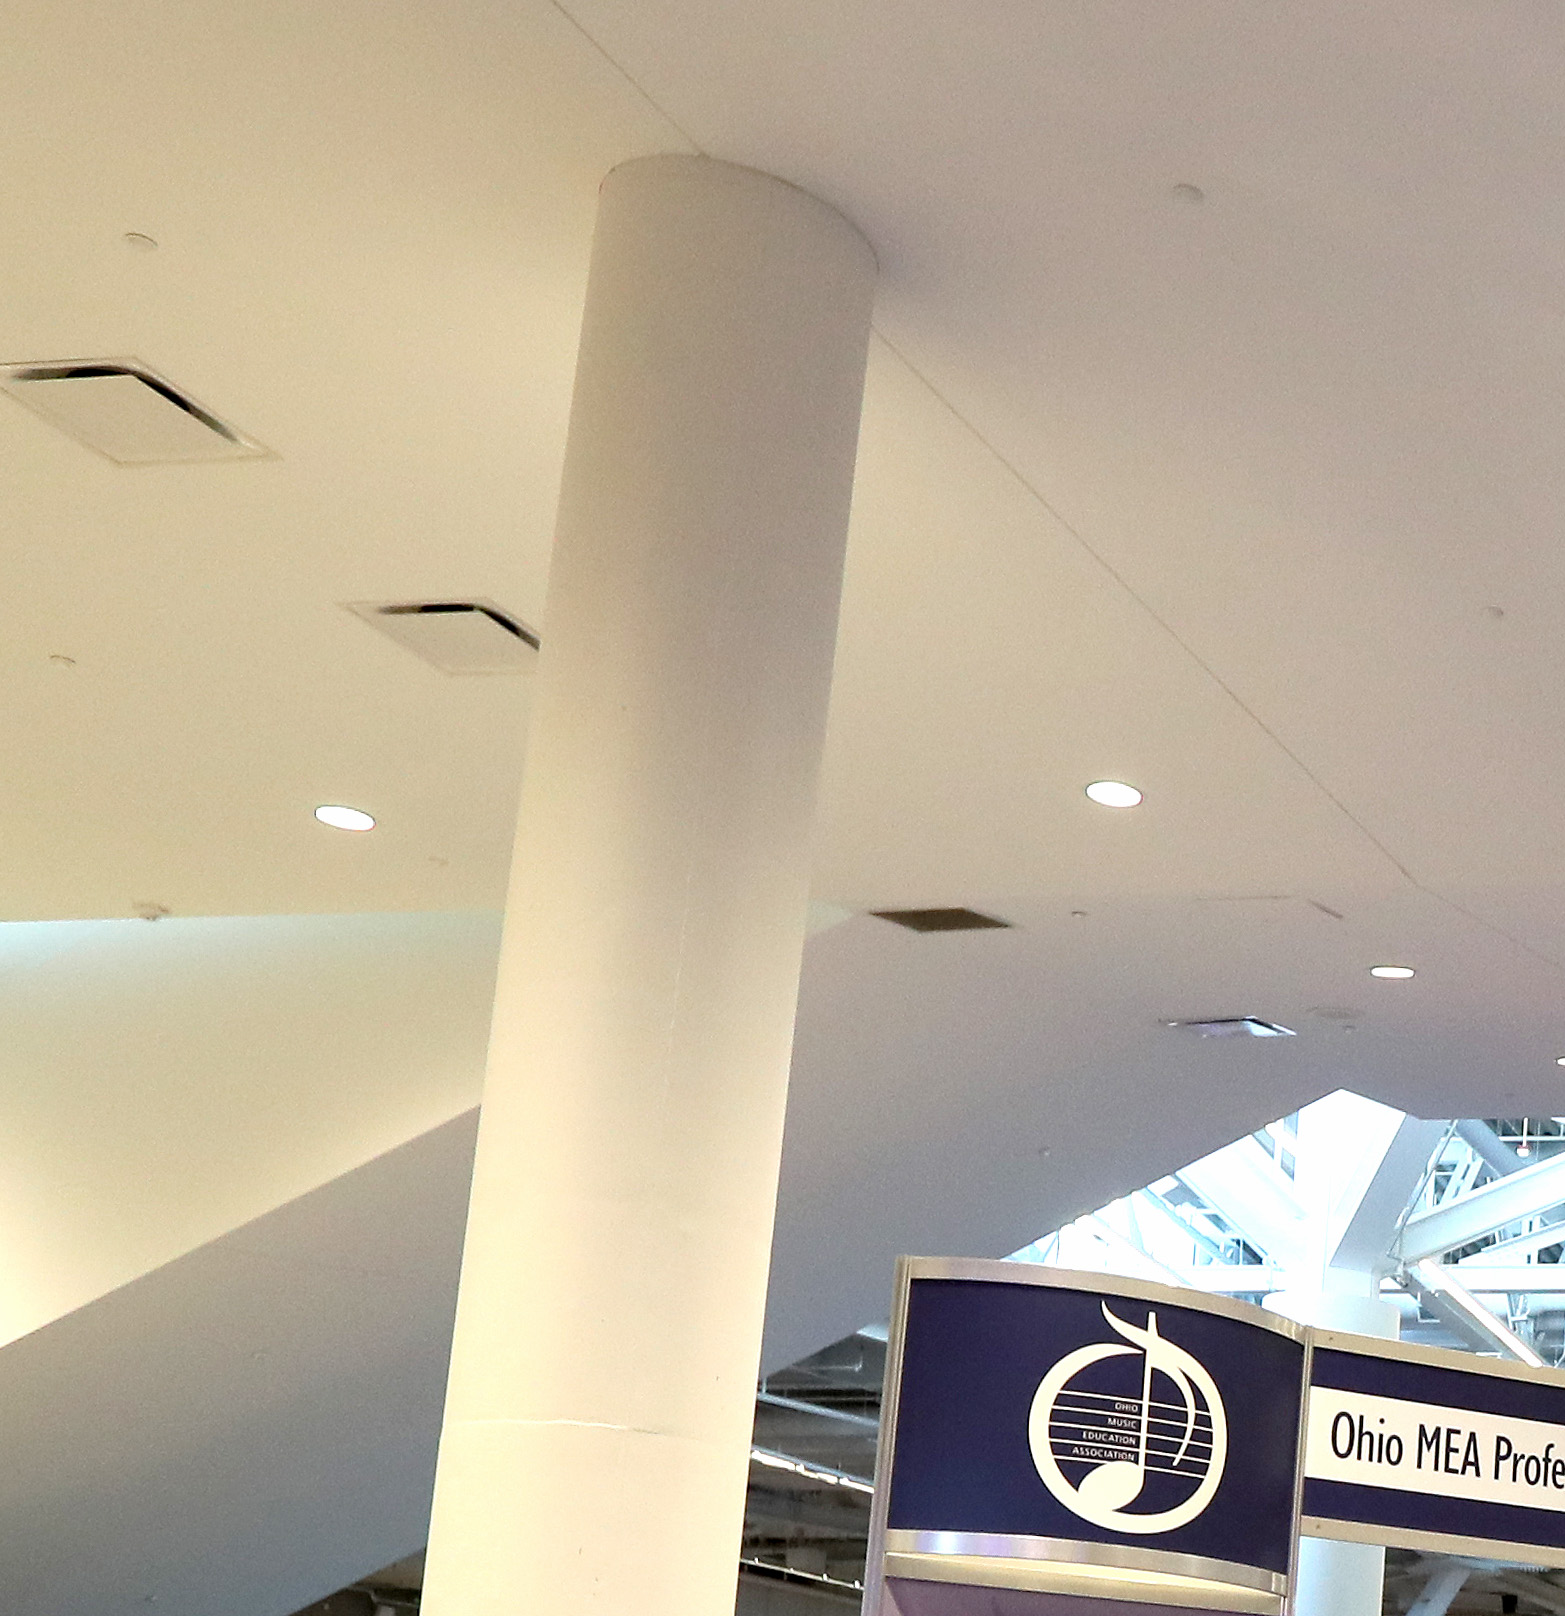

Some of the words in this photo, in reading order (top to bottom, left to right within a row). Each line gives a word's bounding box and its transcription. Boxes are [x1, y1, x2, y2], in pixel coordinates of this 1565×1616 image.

[1115, 1402, 1138, 1412] OHIO
[1108, 1417, 1136, 1429] MUSIC
[1082, 1430, 1135, 1445] EDUCATION
[1331, 1411, 1403, 1466] Ohio
[1416, 1423, 1481, 1478] MEA
[1072, 1446, 1134, 1461] ASSOCIATION
